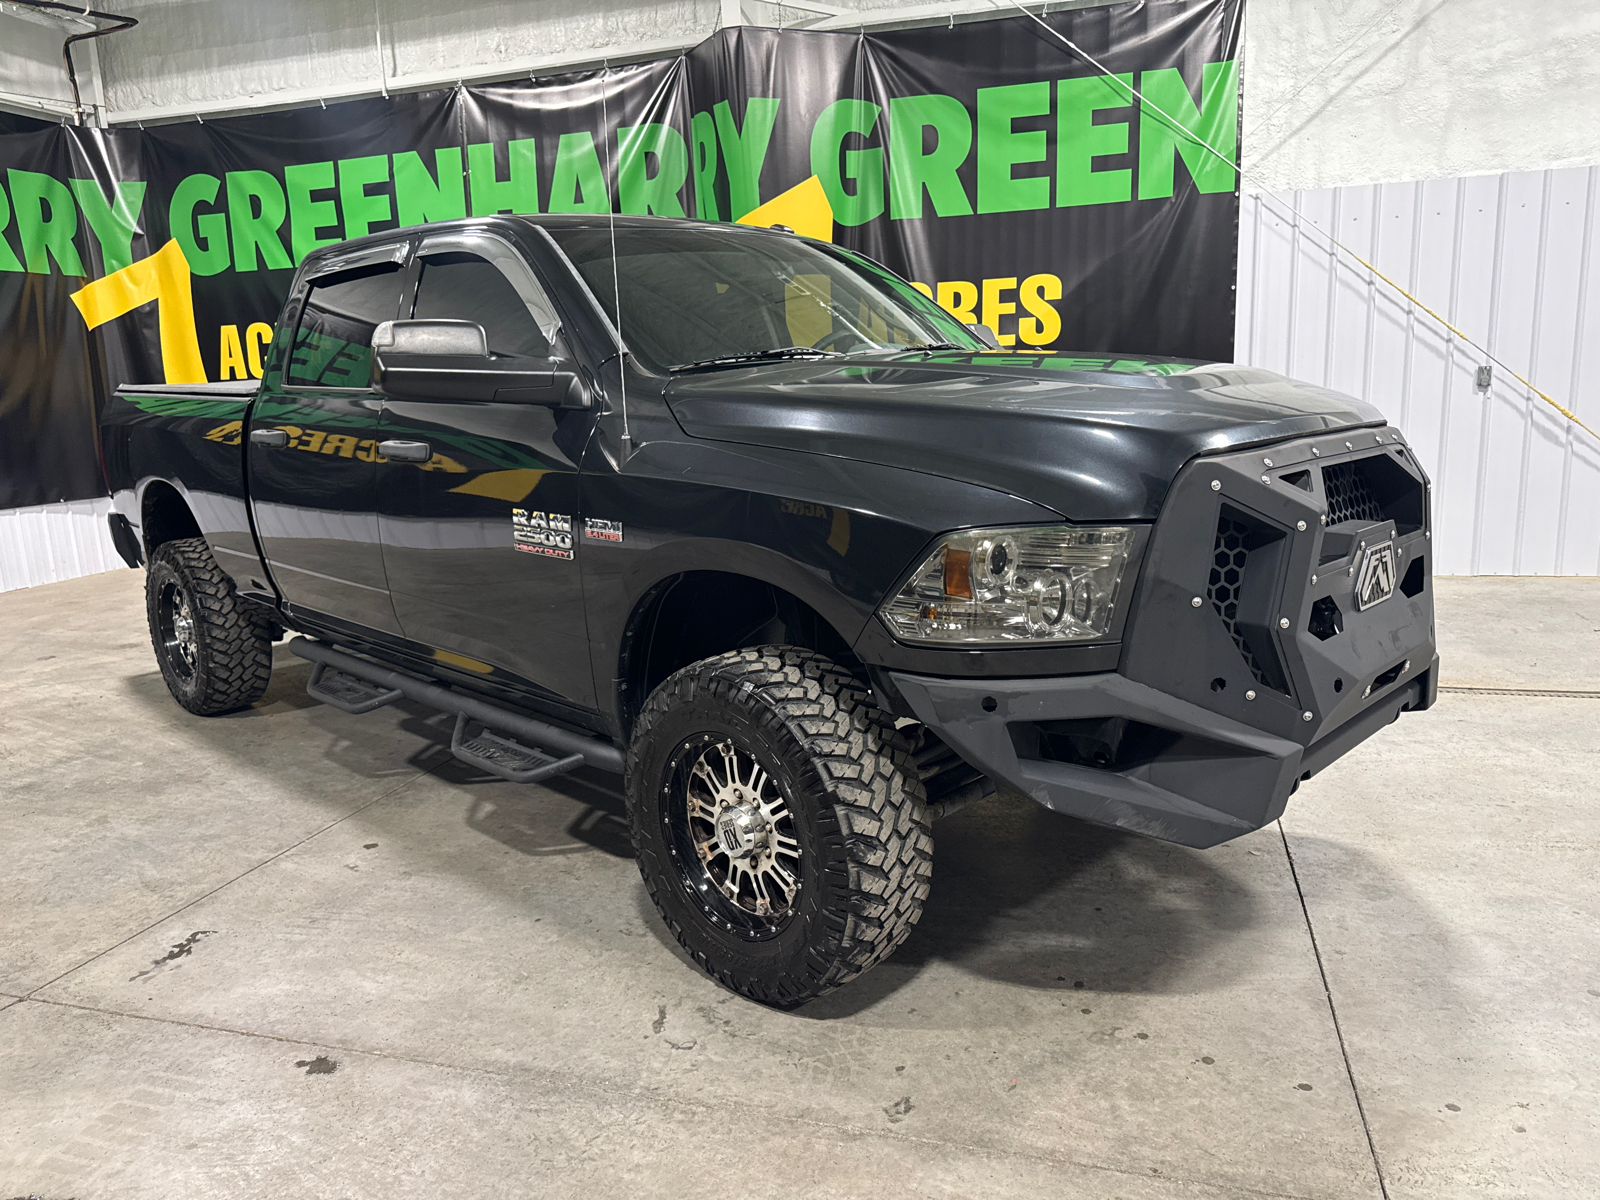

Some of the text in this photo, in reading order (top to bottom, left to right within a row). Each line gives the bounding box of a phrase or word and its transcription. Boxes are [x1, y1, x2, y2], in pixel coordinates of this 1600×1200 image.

[467, 60, 1239, 226] HARRY GREEN
[168, 146, 466, 277] GREEN
[70, 237, 208, 384] 7
[512, 508, 571, 532] RAM
[585, 518, 622, 533] HEMI
[514, 525, 572, 549] 2500
[516, 543, 569, 557] HEAVY DUTY
